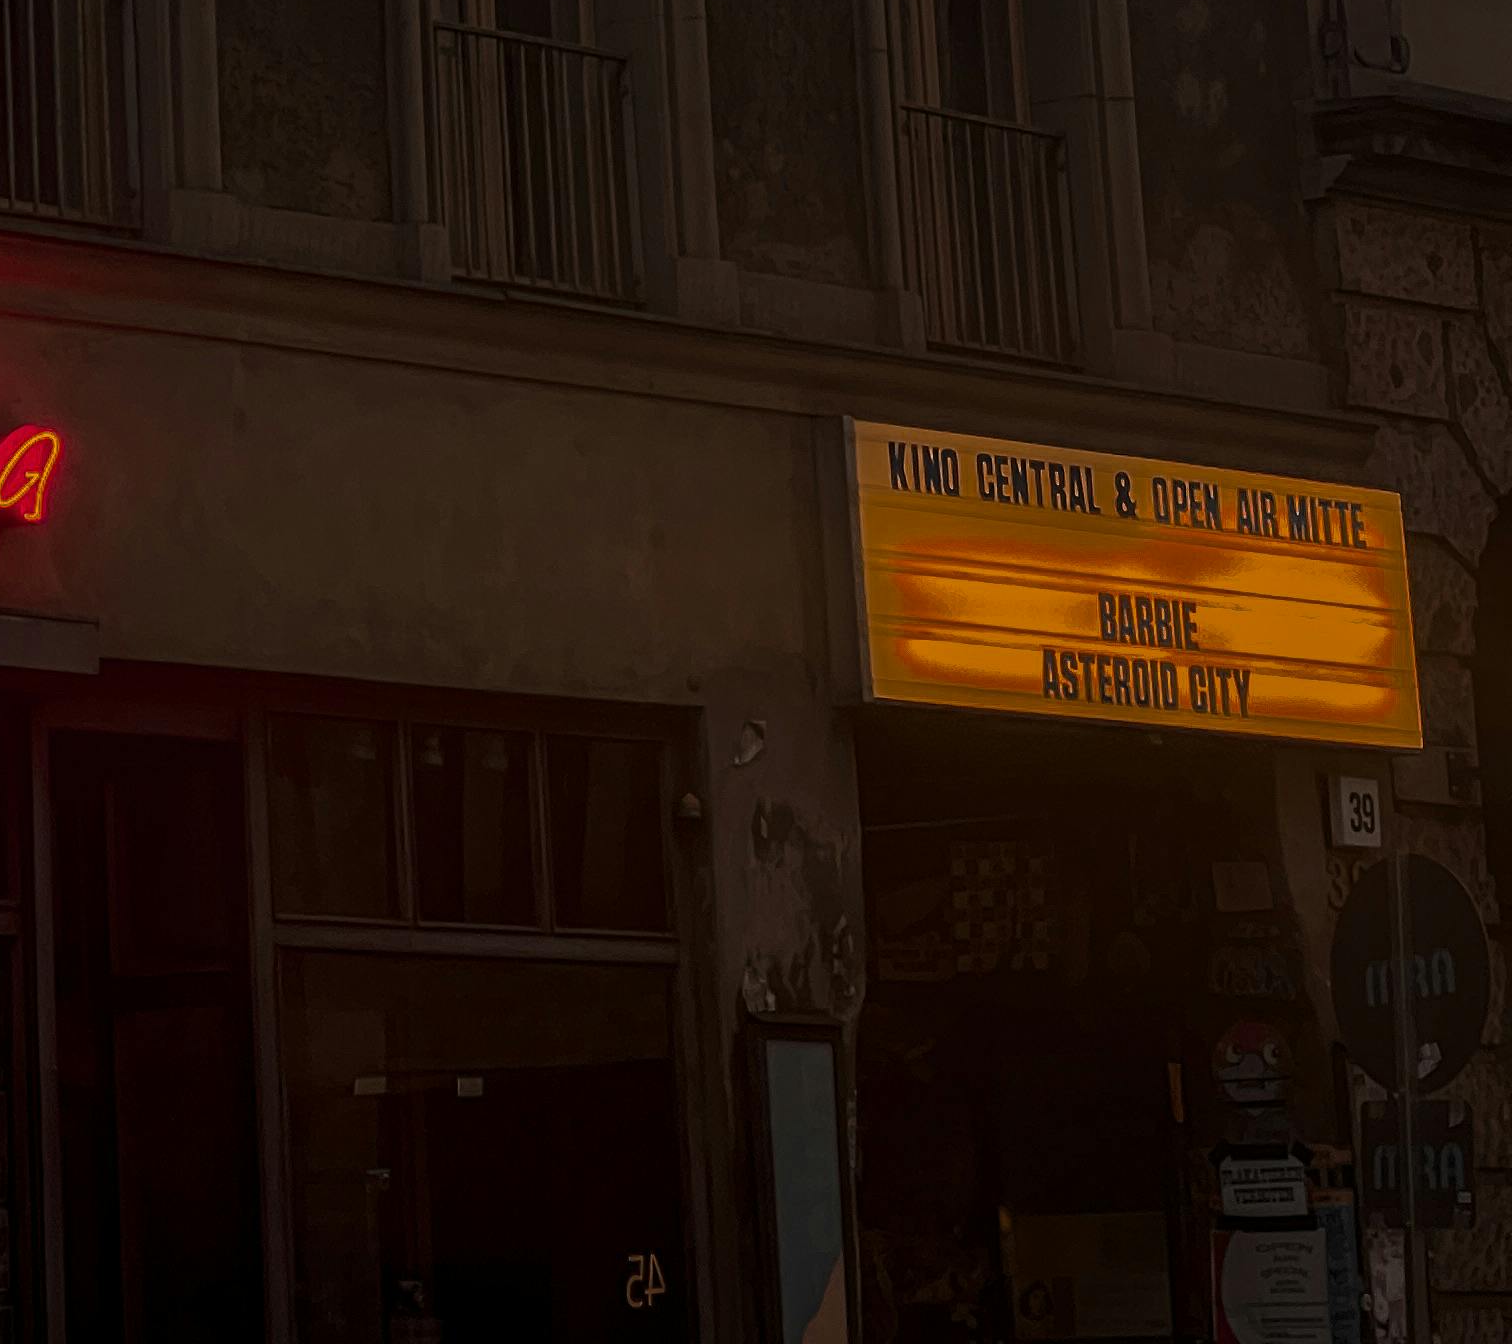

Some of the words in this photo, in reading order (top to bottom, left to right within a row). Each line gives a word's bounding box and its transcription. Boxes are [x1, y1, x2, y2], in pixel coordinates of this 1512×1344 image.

[888, 442, 961, 497] KINO
[976, 453, 1101, 515] CENTRAL
[1114, 472, 1137, 519] &
[1153, 477, 1222, 531] OPEN
[1235, 490, 1281, 538] AIR
[1287, 495, 1368, 550] MITTE
[1098, 592, 1199, 651] BARBIE
[1042, 649, 1178, 711] ASTEROID
[1190, 666, 1251, 718] CITY
[1349, 791, 1377, 835] 39
